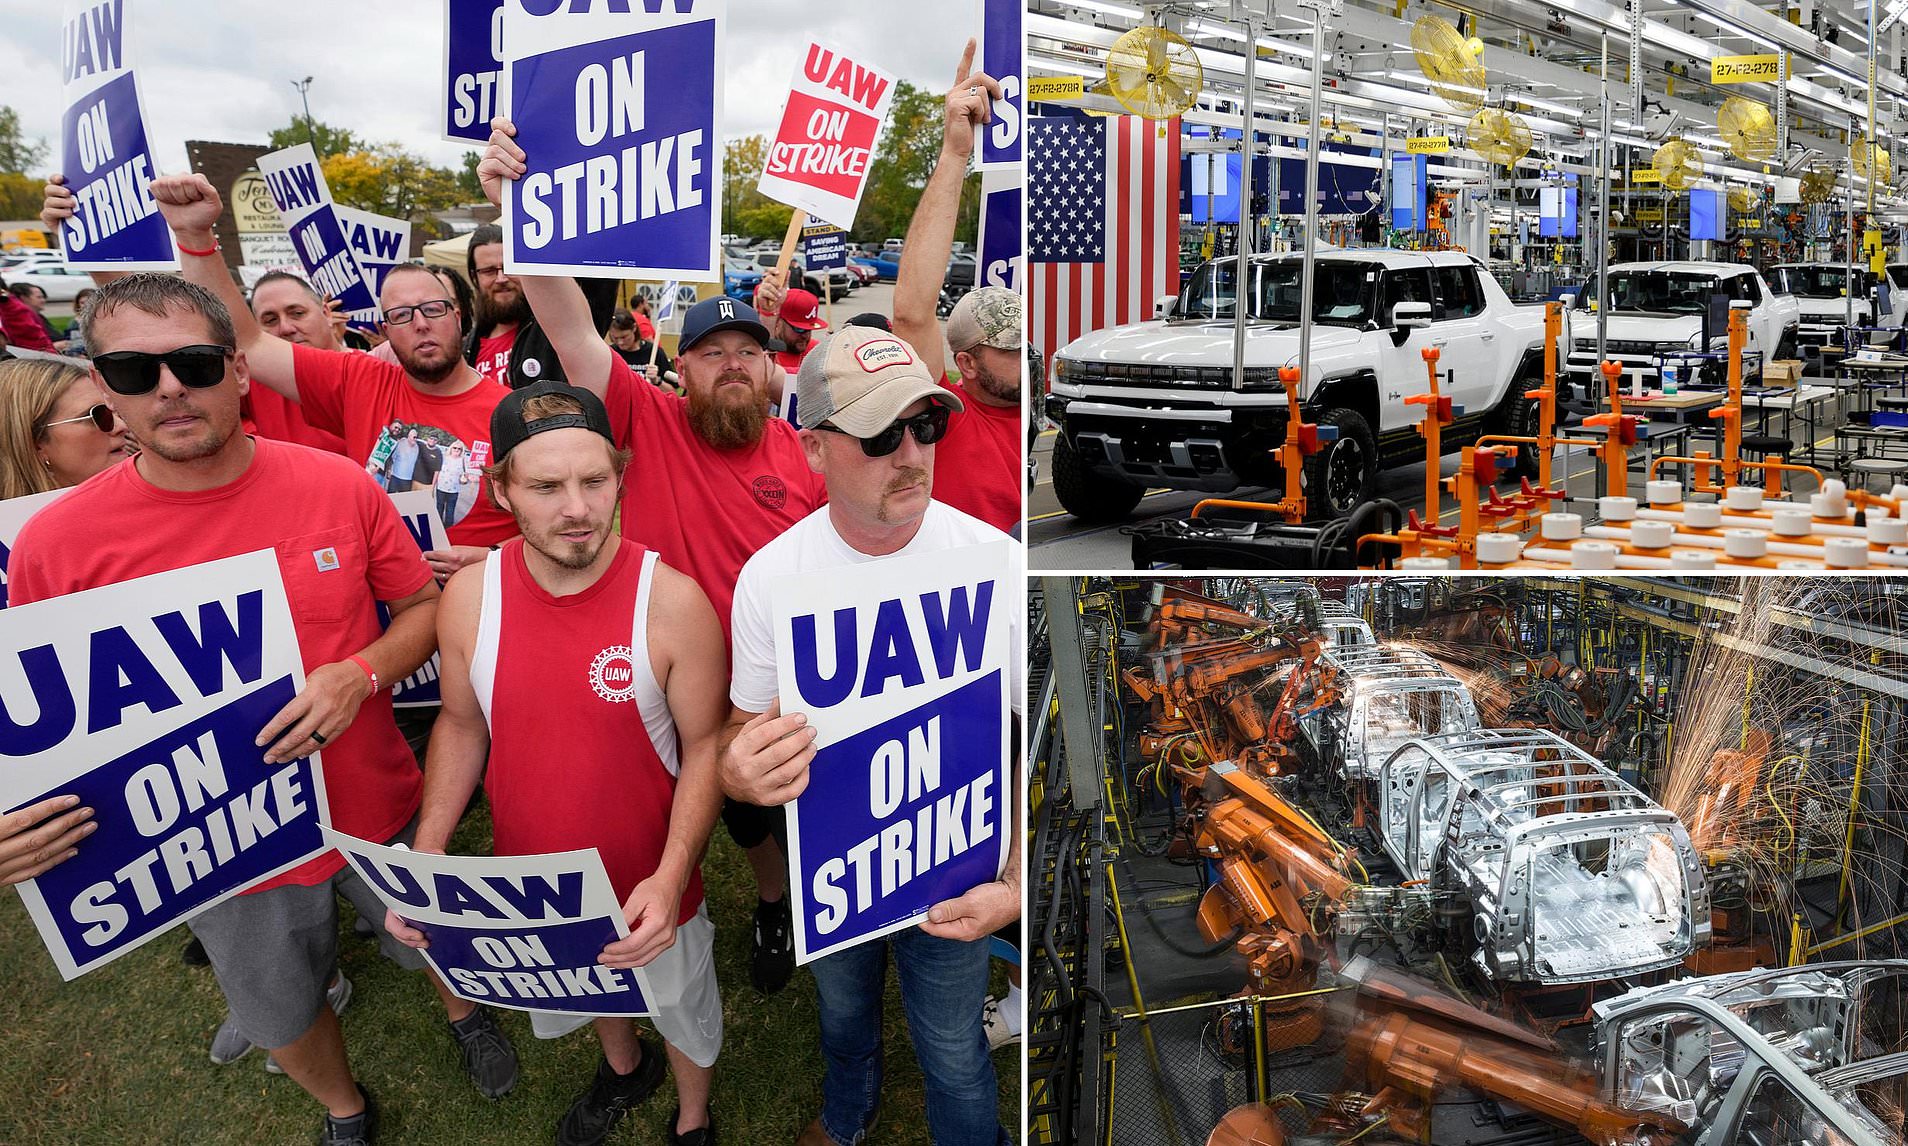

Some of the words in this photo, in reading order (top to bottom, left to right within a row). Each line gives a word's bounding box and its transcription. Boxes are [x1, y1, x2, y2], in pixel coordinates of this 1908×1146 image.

[63, 0, 124, 86] UAW
[804, 43, 889, 111] UAW
[1716, 62, 1779, 76] 27-F2-278
[575, 50, 645, 147] ON
[1029, 83, 1080, 94] 27-F2-278R
[77, 99, 115, 175] ON
[768, 141, 870, 177] STRIKE
[806, 108, 850, 142] ON
[65, 153, 159, 253] STRIKE
[265, 163, 321, 212] UAW
[521, 128, 703, 250] STRIKE
[301, 221, 328, 266] ON
[340, 219, 403, 261] AW
[0, 589, 262, 757] UAW
[605, 667, 631, 682] UAW
[791, 580, 995, 708] UAW
[125, 730, 229, 838] ON
[870, 715, 941, 820] ON
[70, 763, 307, 947] STRIKE
[348, 851, 584, 920] UAW
[813, 769, 994, 935] STRIKE
[448, 965, 630, 999] STRIKE
[471, 935, 555, 968] ON
